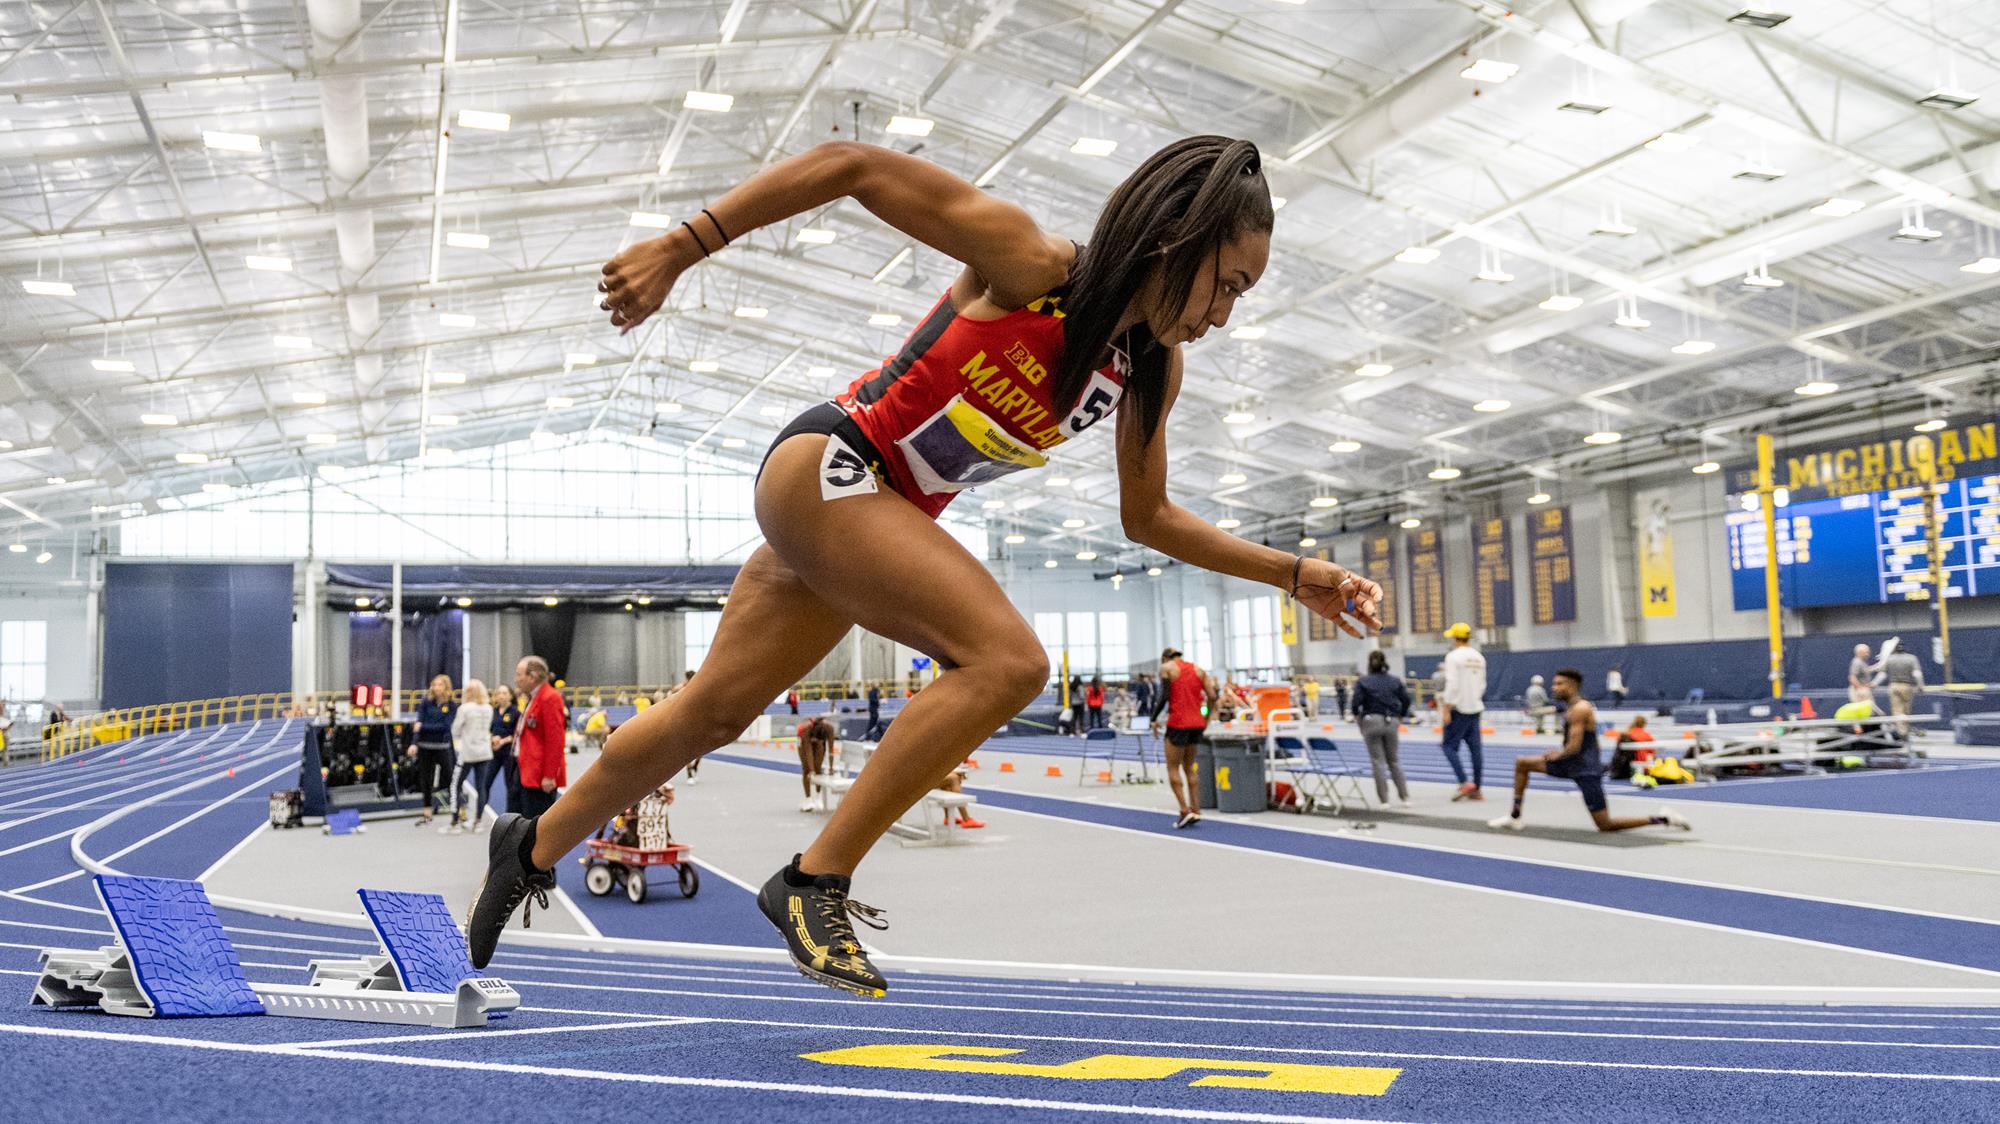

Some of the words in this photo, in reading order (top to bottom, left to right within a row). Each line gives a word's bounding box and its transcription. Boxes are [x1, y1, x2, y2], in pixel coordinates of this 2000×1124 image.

[1070, 387, 1114, 433] 5
[826, 448, 867, 487] 5
[1787, 422, 1997, 490] MICHIGAN
[788, 895, 819, 958] SPEE
[476, 979, 507, 989] GILL
[797, 1043, 1402, 1097] 5
